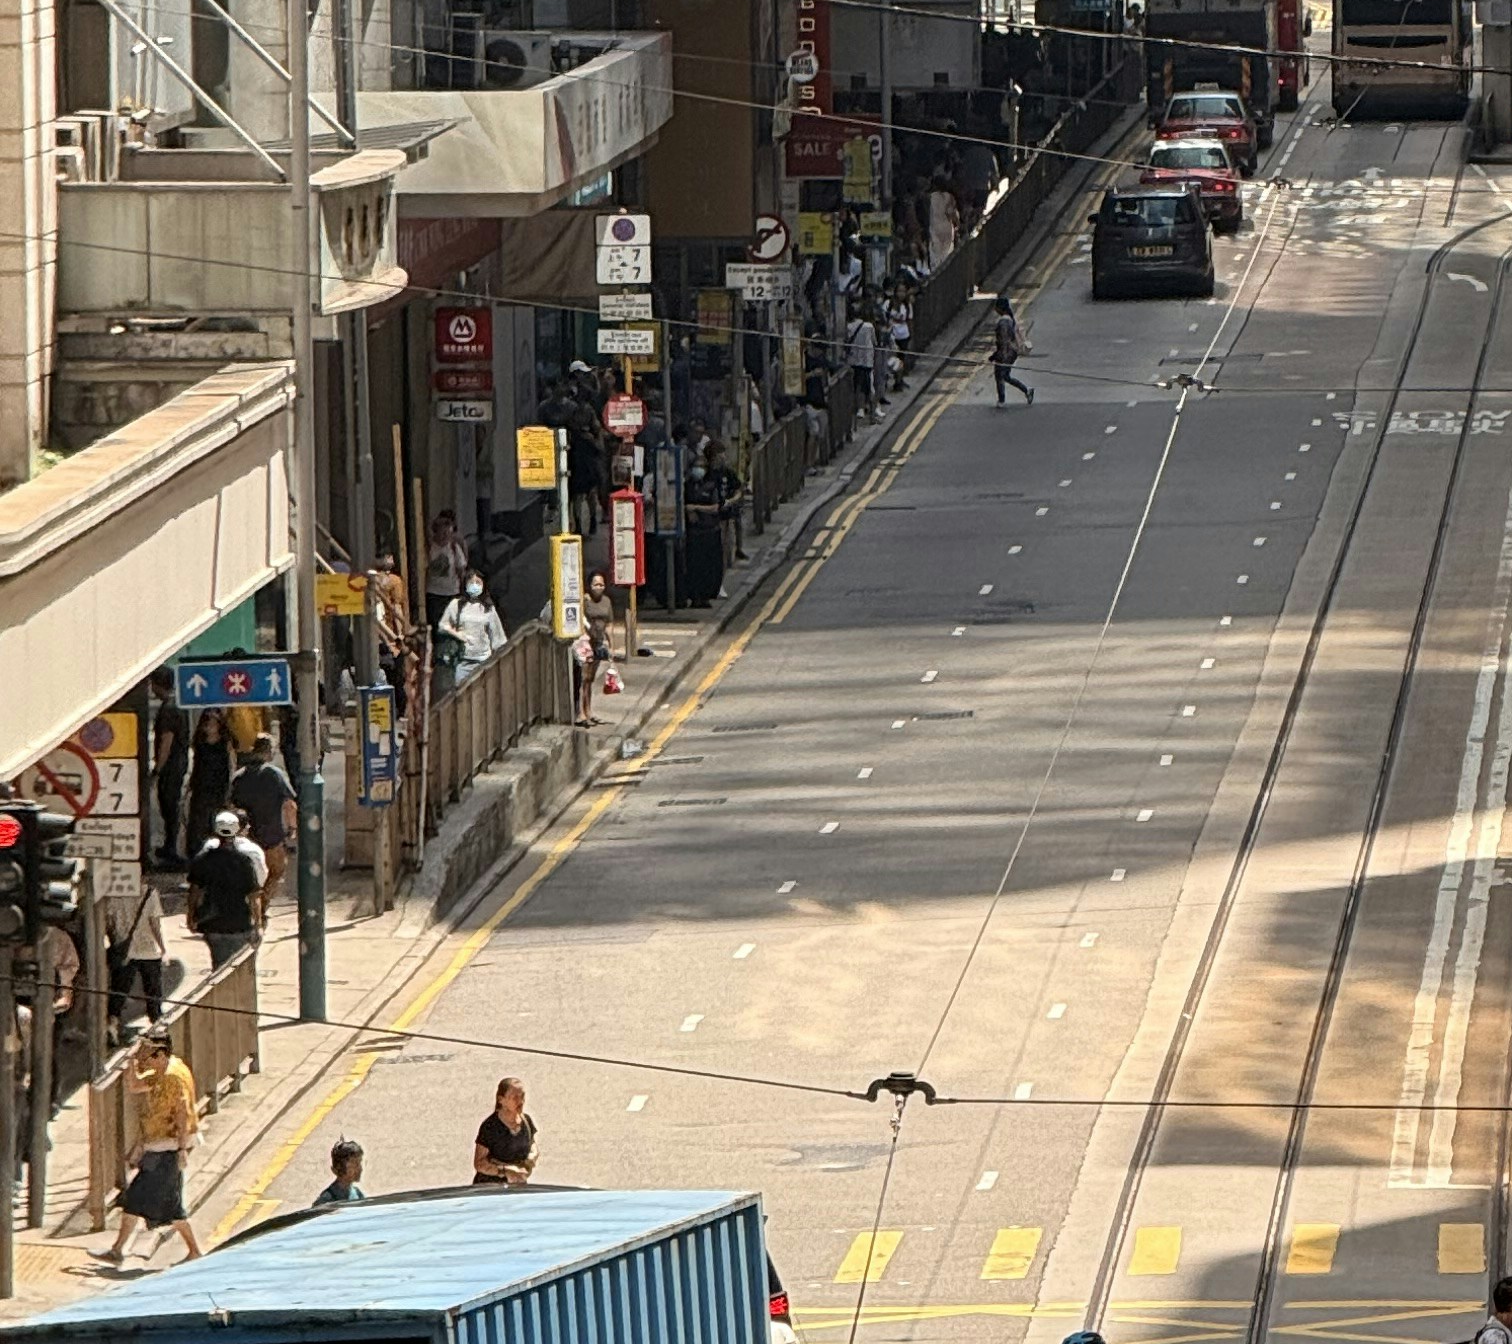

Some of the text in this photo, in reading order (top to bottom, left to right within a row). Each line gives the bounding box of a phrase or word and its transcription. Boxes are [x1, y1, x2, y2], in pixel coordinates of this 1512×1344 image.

[794, 141, 831, 157] SALE
[632, 248, 641, 262] 7
[632, 267, 641, 280] 7
[751, 286, 765, 298] 12
[109, 763, 123, 783] 7
[110, 793, 123, 812] 7
